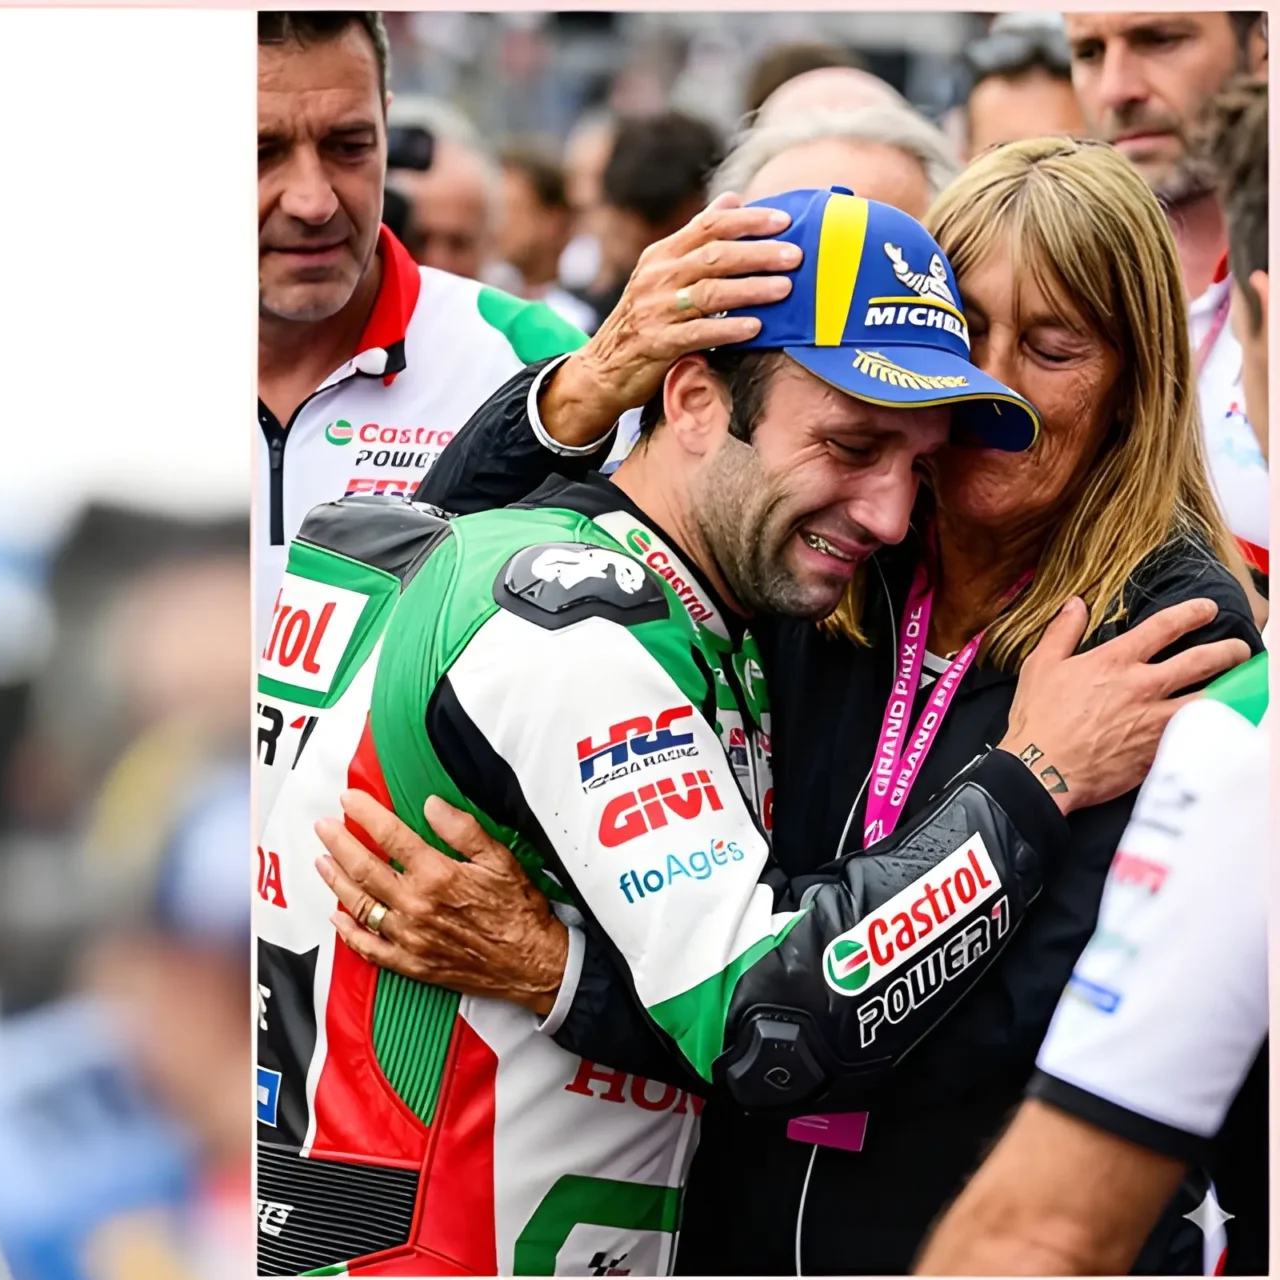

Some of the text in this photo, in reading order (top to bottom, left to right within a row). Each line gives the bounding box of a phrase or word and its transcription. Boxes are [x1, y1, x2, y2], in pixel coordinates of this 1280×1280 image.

[359, 423, 454, 447] Castro
[576, 705, 694, 784] HRC
[598, 769, 724, 848] GIVI
[867, 848, 992, 966] Castrol
[564, 1056, 707, 1117] HON
